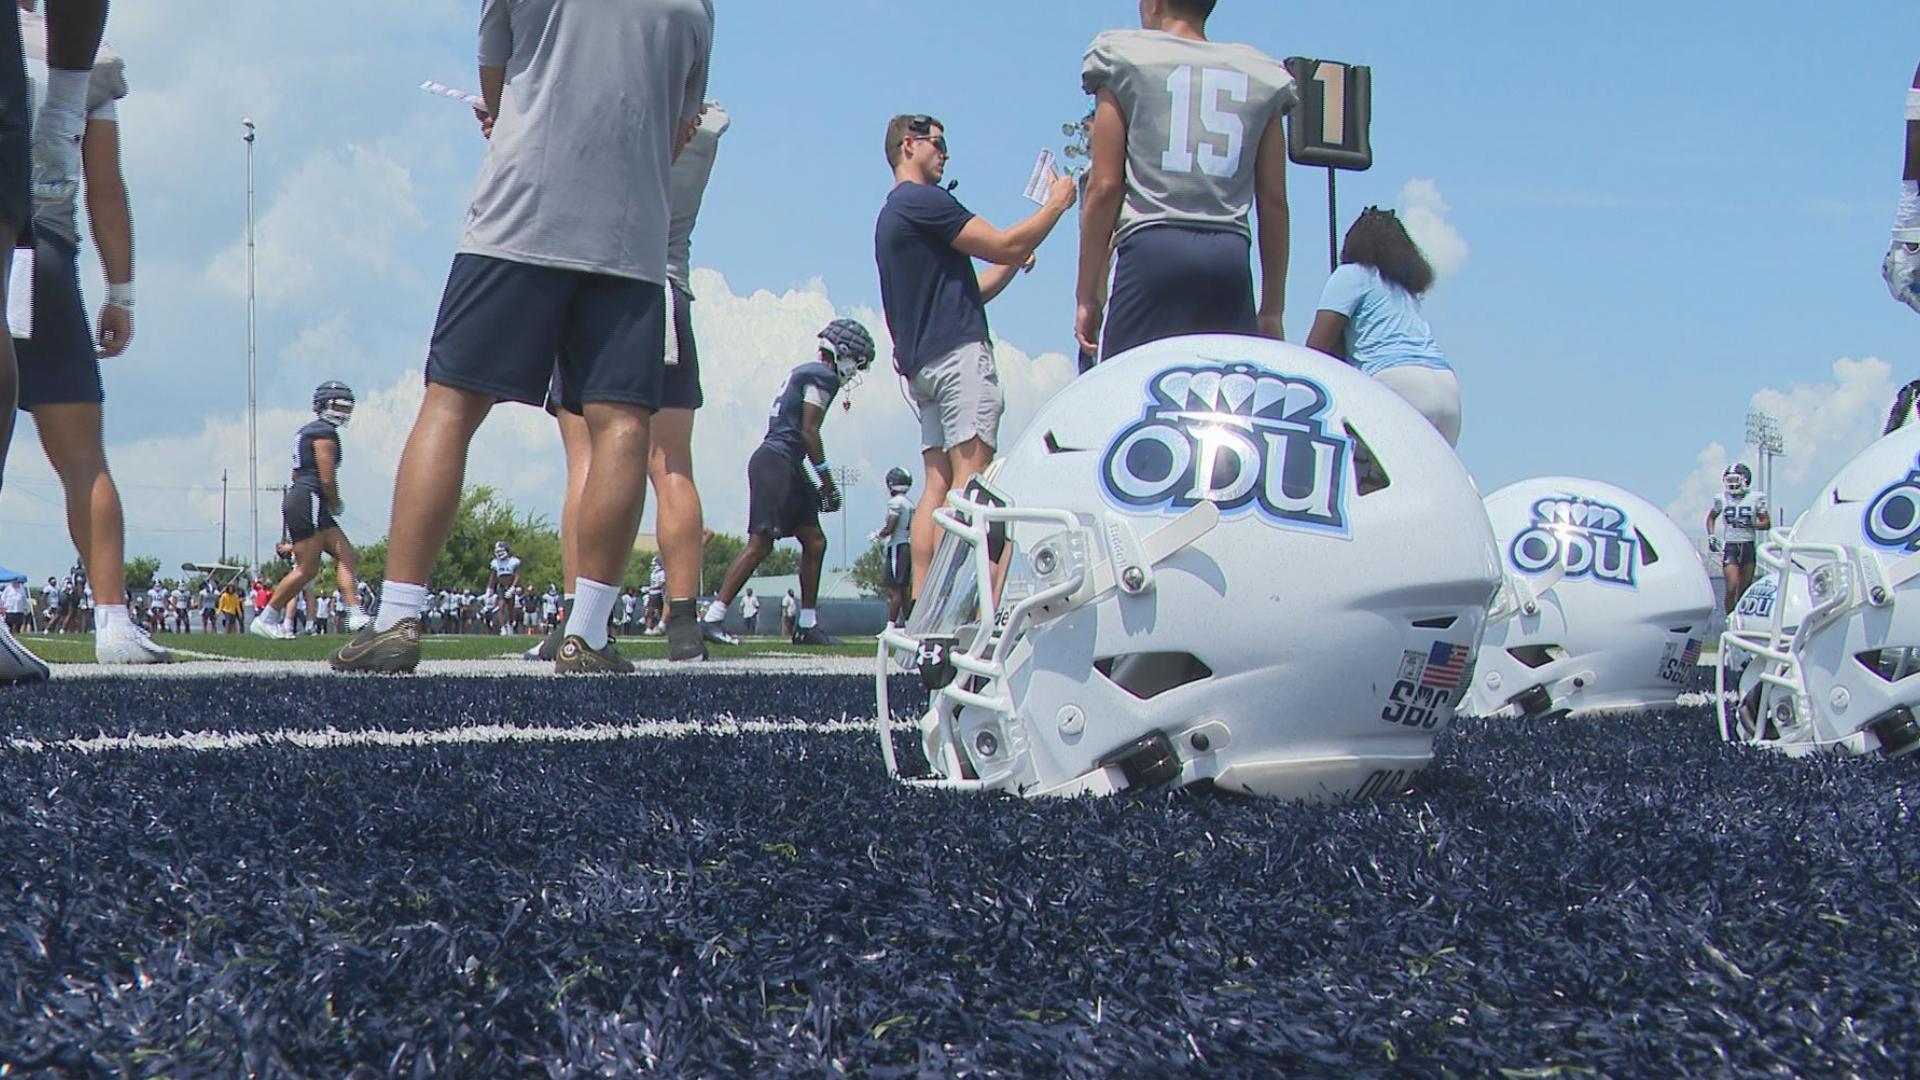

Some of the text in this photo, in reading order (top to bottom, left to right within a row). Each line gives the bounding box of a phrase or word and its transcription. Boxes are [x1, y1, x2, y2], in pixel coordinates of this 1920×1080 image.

[1161, 65, 1249, 179] 15
[1313, 62, 1346, 145] 1
[1106, 421, 1340, 520] ODU
[1511, 526, 1634, 583] ODU
[1738, 597, 1773, 617] ODU
[1381, 679, 1450, 729] SBC
